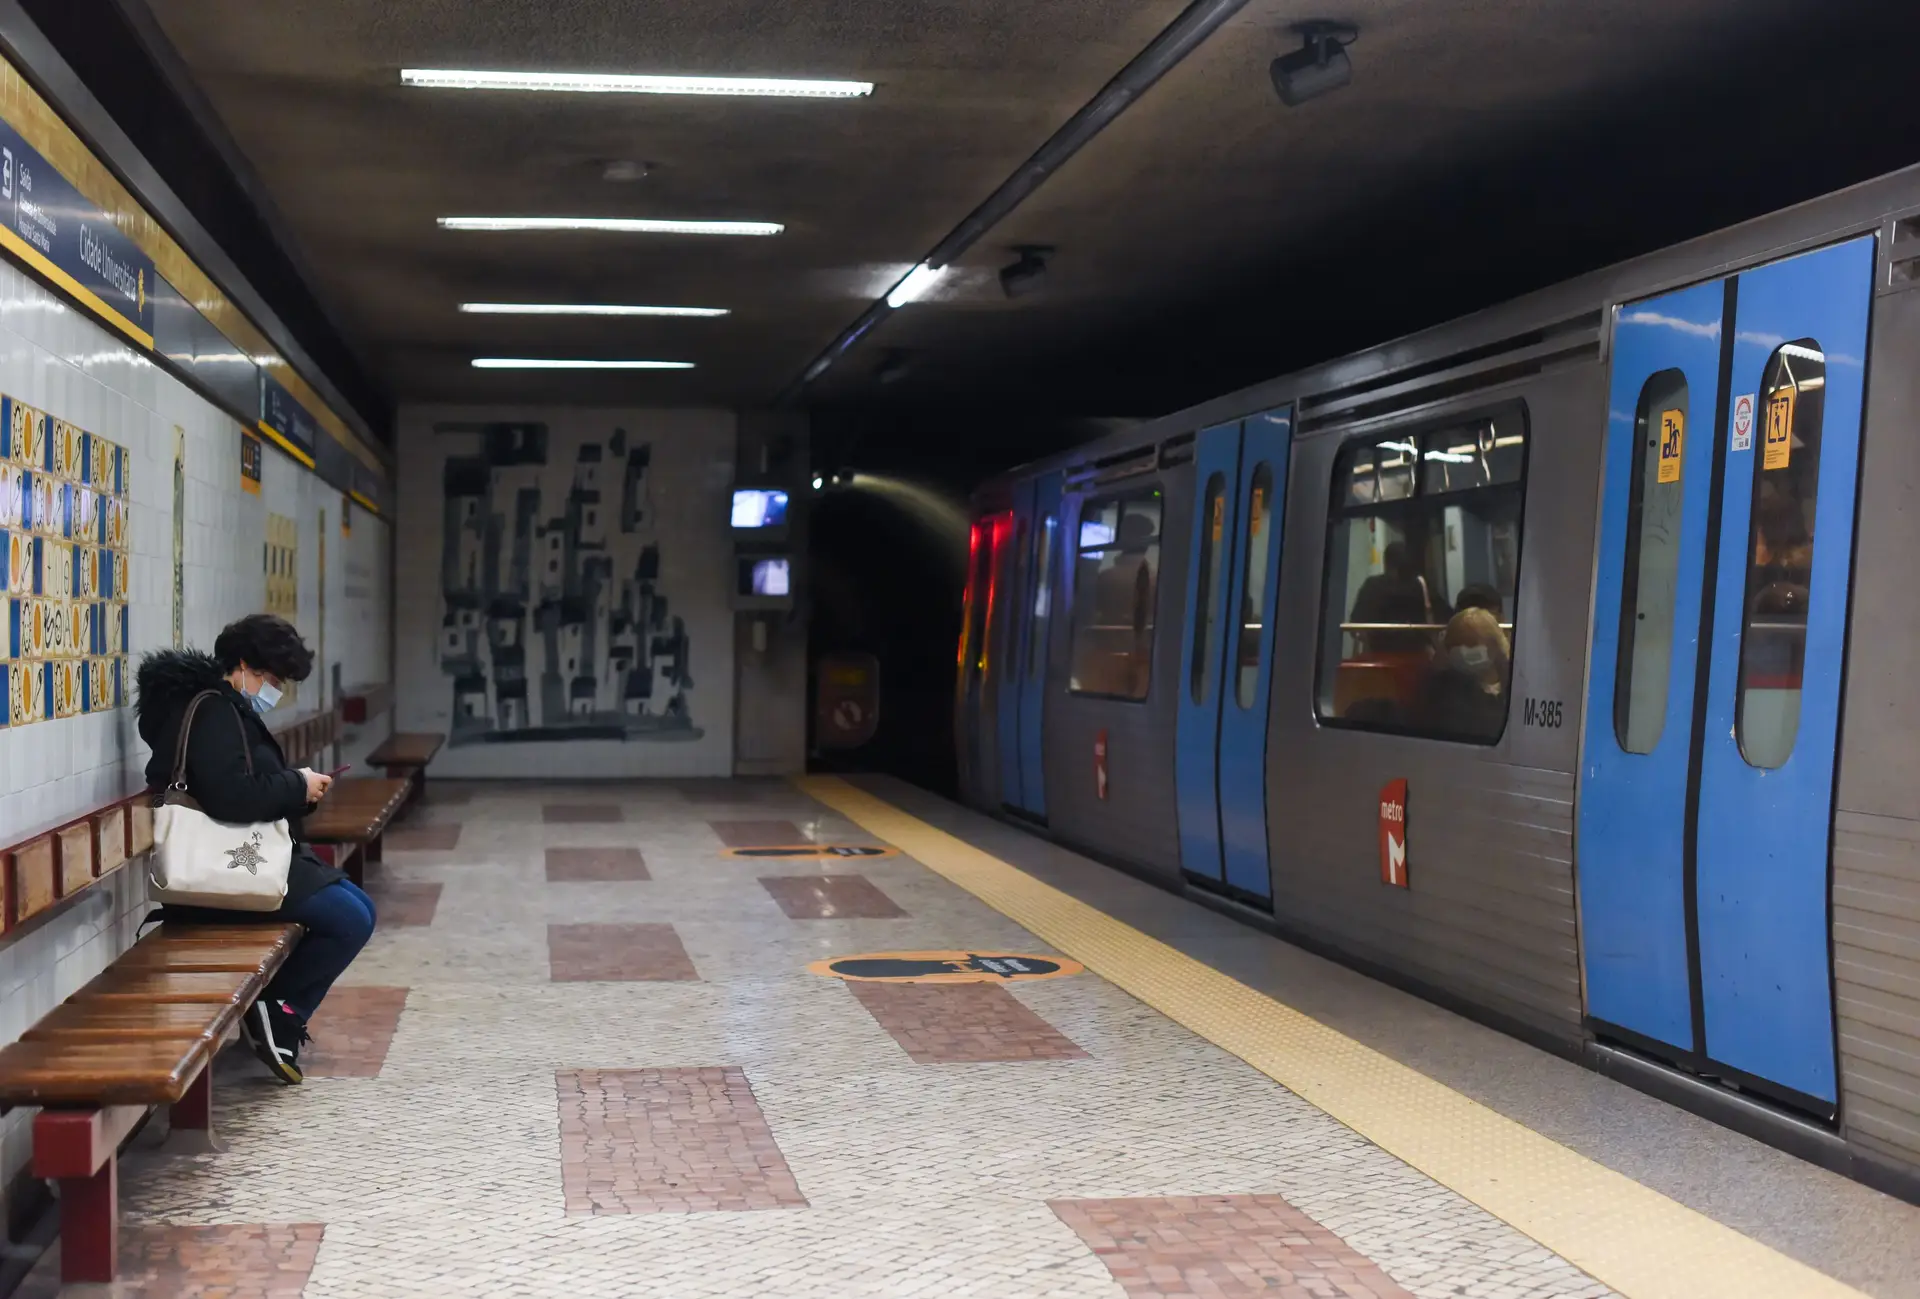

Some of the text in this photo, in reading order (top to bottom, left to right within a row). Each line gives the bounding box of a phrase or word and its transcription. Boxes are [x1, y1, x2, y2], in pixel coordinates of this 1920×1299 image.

[79, 223, 137, 302] Cidade Universitária
[1524, 698, 1563, 728] M-385
[1381, 799, 1403, 822] metro
